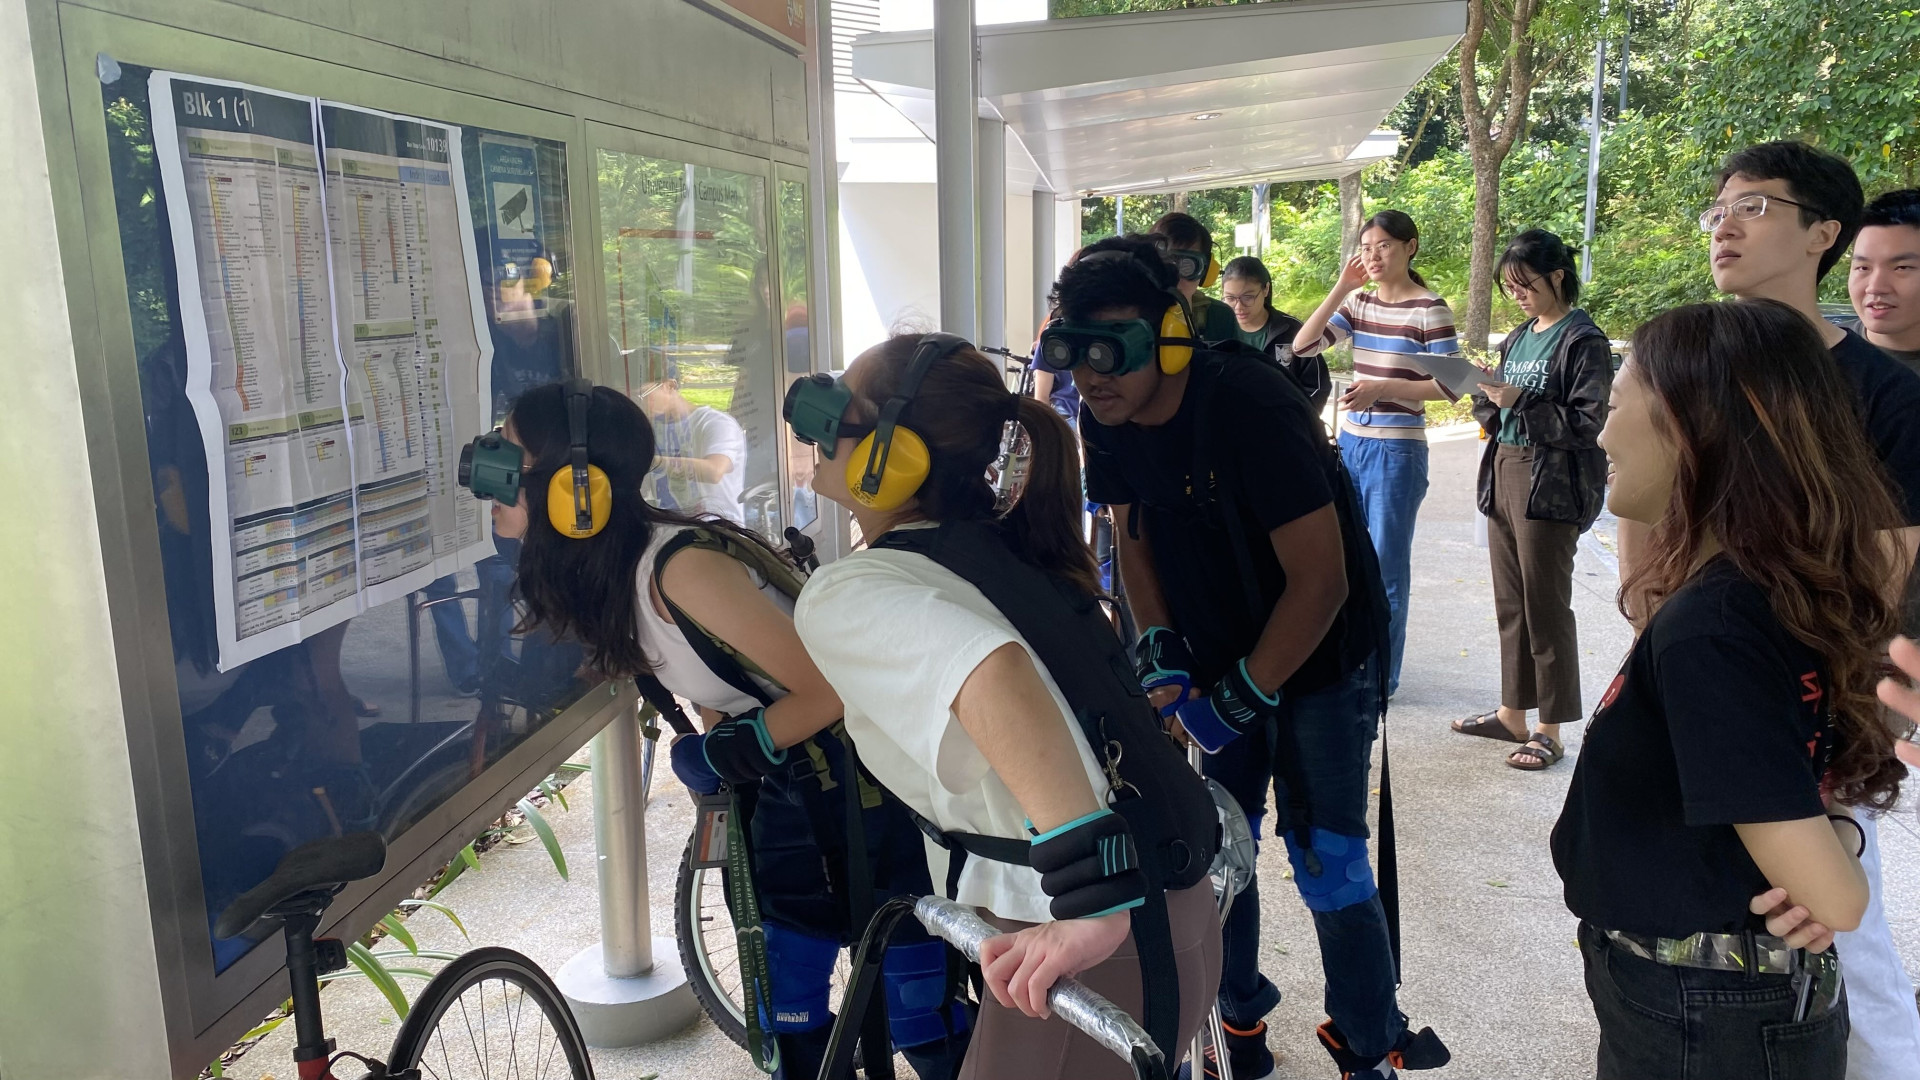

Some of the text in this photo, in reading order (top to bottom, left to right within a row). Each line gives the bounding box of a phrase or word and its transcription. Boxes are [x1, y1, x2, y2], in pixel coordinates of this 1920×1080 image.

[183, 91, 254, 128] Blk 1 (1)
[426, 137, 447, 153] 10139
[641, 173, 678, 203] University
[680, 177, 697, 199] Ton
[698, 181, 723, 207] Campus
[231, 427, 242, 436] 123
[730, 839, 744, 921] TEMBUSU COLLEGE
[755, 939, 766, 975] COLLEGE
[740, 940, 755, 1023] TEMBUSU COLLEGE
